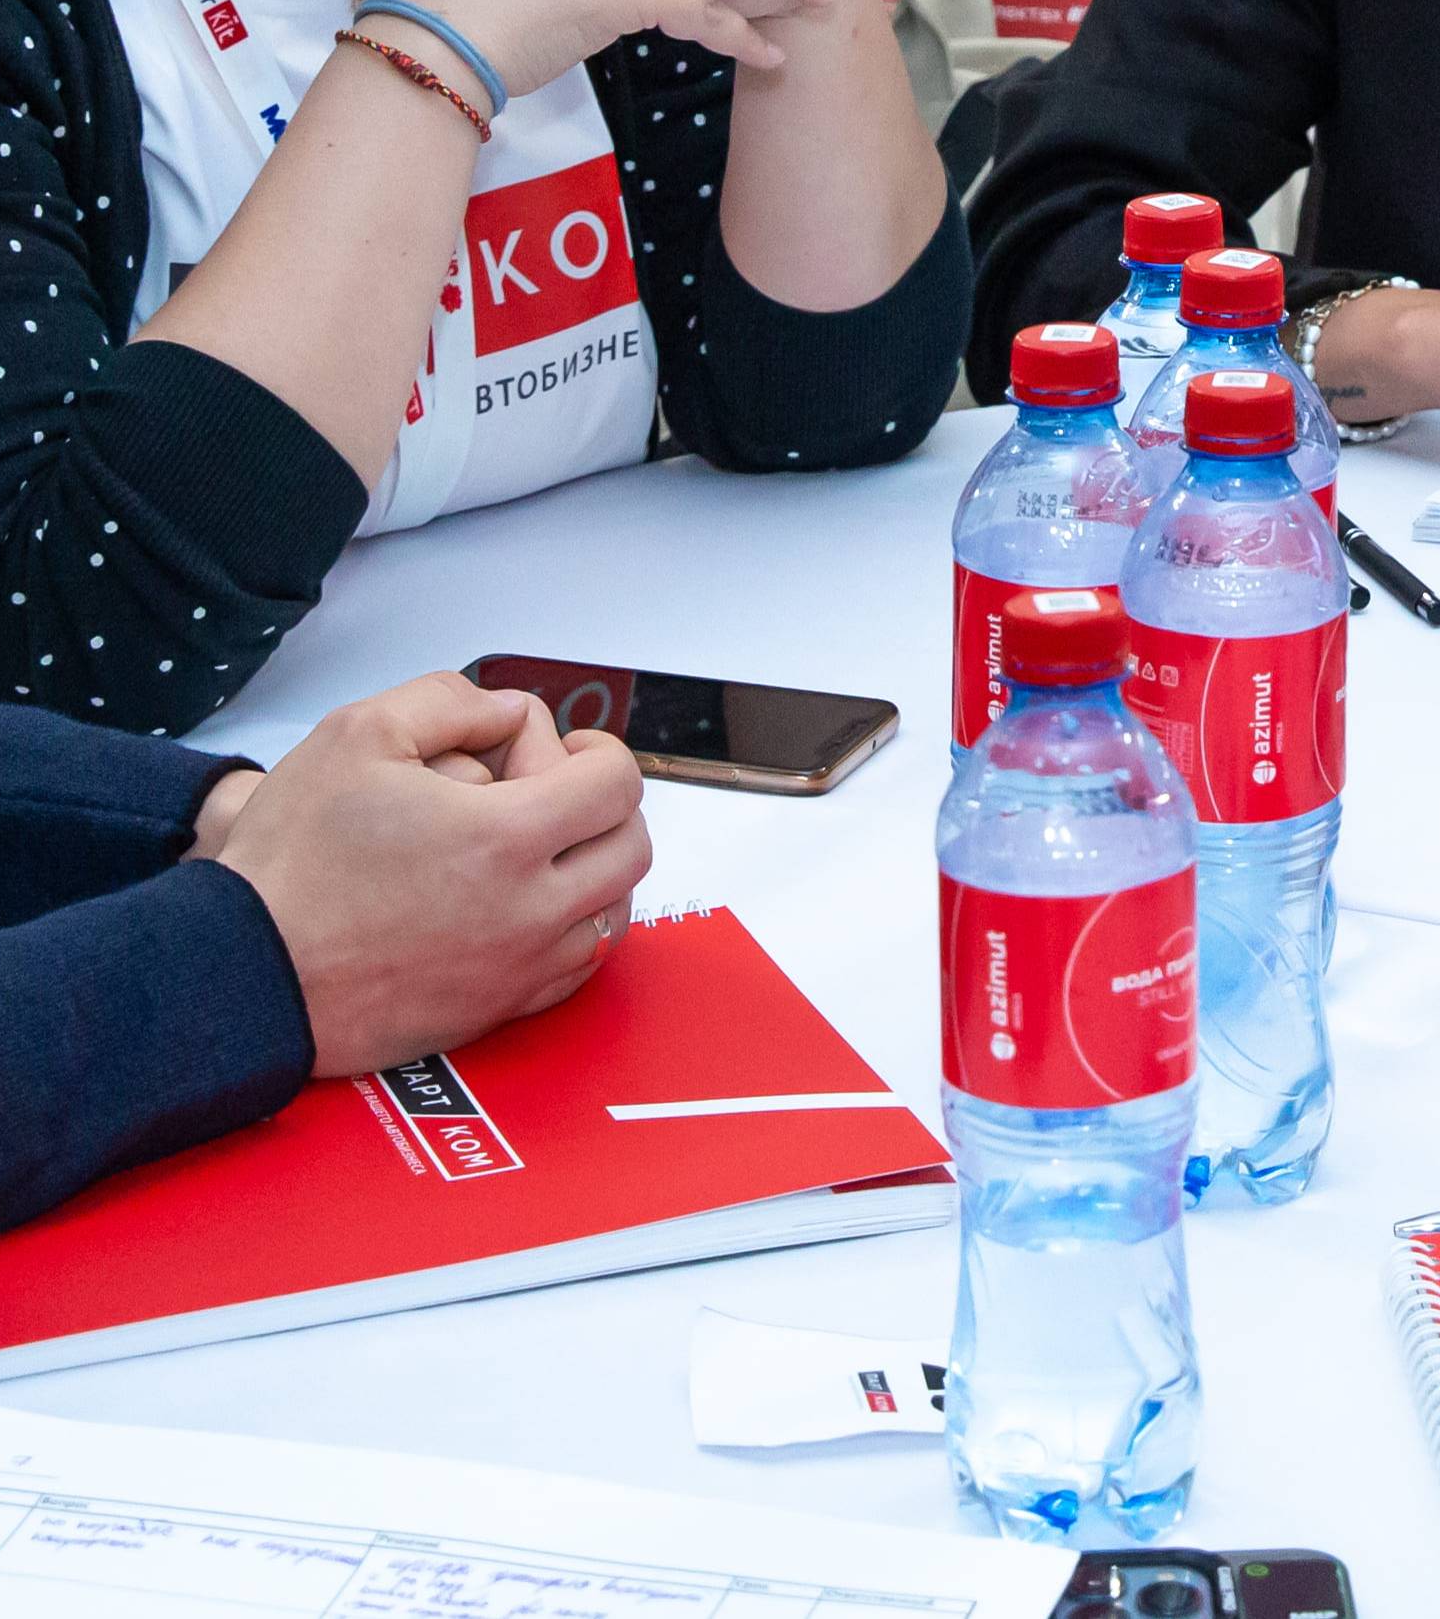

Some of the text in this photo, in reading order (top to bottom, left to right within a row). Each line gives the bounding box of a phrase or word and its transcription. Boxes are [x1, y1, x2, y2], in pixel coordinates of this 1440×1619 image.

[479, 194, 630, 306] КО
[475, 329, 641, 416] ВТОБИЗНЕ
[1248, 672, 1273, 756] azimut
[984, 929, 1008, 1027] azimut
[383, 1123, 428, 1177] АВТОБИЗНЕСА
[439, 1124, 494, 1169] КОМ
